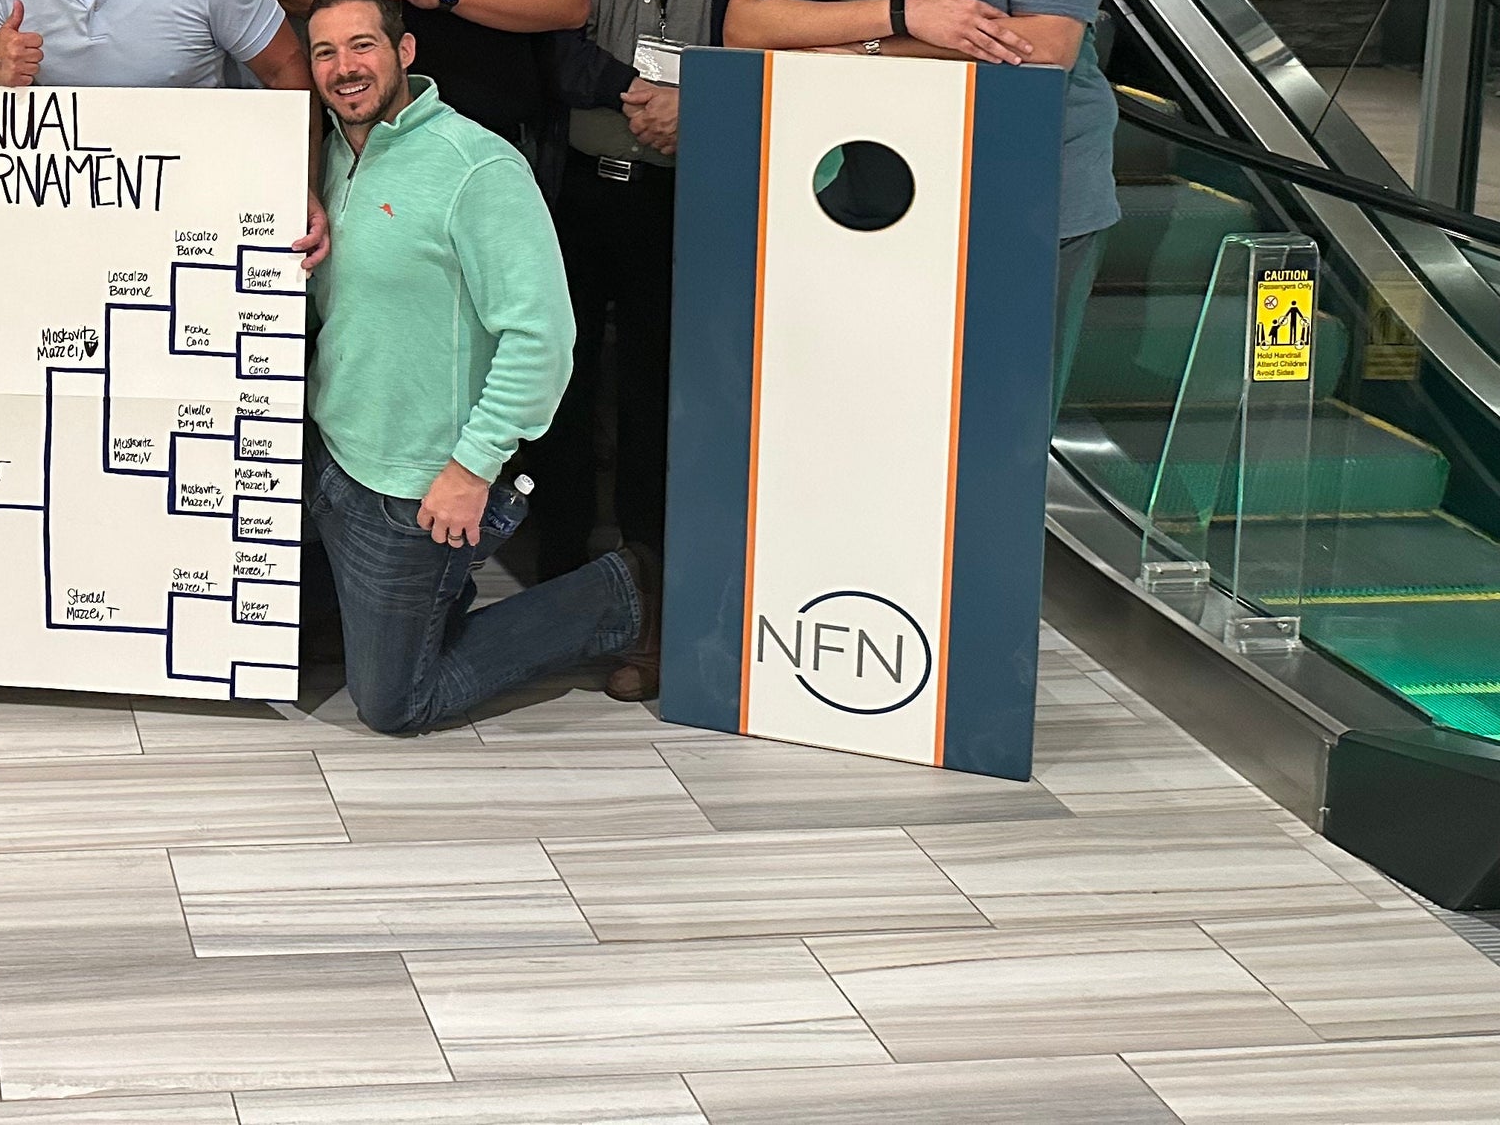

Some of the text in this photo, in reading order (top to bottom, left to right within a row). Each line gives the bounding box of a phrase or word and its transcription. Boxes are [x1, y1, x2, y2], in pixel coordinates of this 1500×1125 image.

[175, 230, 218, 242] Loscalzo
[242, 226, 275, 237] Barone
[176, 245, 214, 256] Barone
[108, 271, 148, 283] Loscalzo
[1264, 270, 1309, 281] CAUTION
[109, 285, 153, 297] Barone
[1259, 282, 1312, 291] Passengers Only
[42, 326, 99, 345] Moskovitz
[178, 418, 214, 431] Bryant
[265, 564, 277, 576] T
[206, 582, 218, 591] T
[67, 588, 105, 605] Steidel
[106, 606, 120, 619] T
[757, 614, 903, 684] NFN
